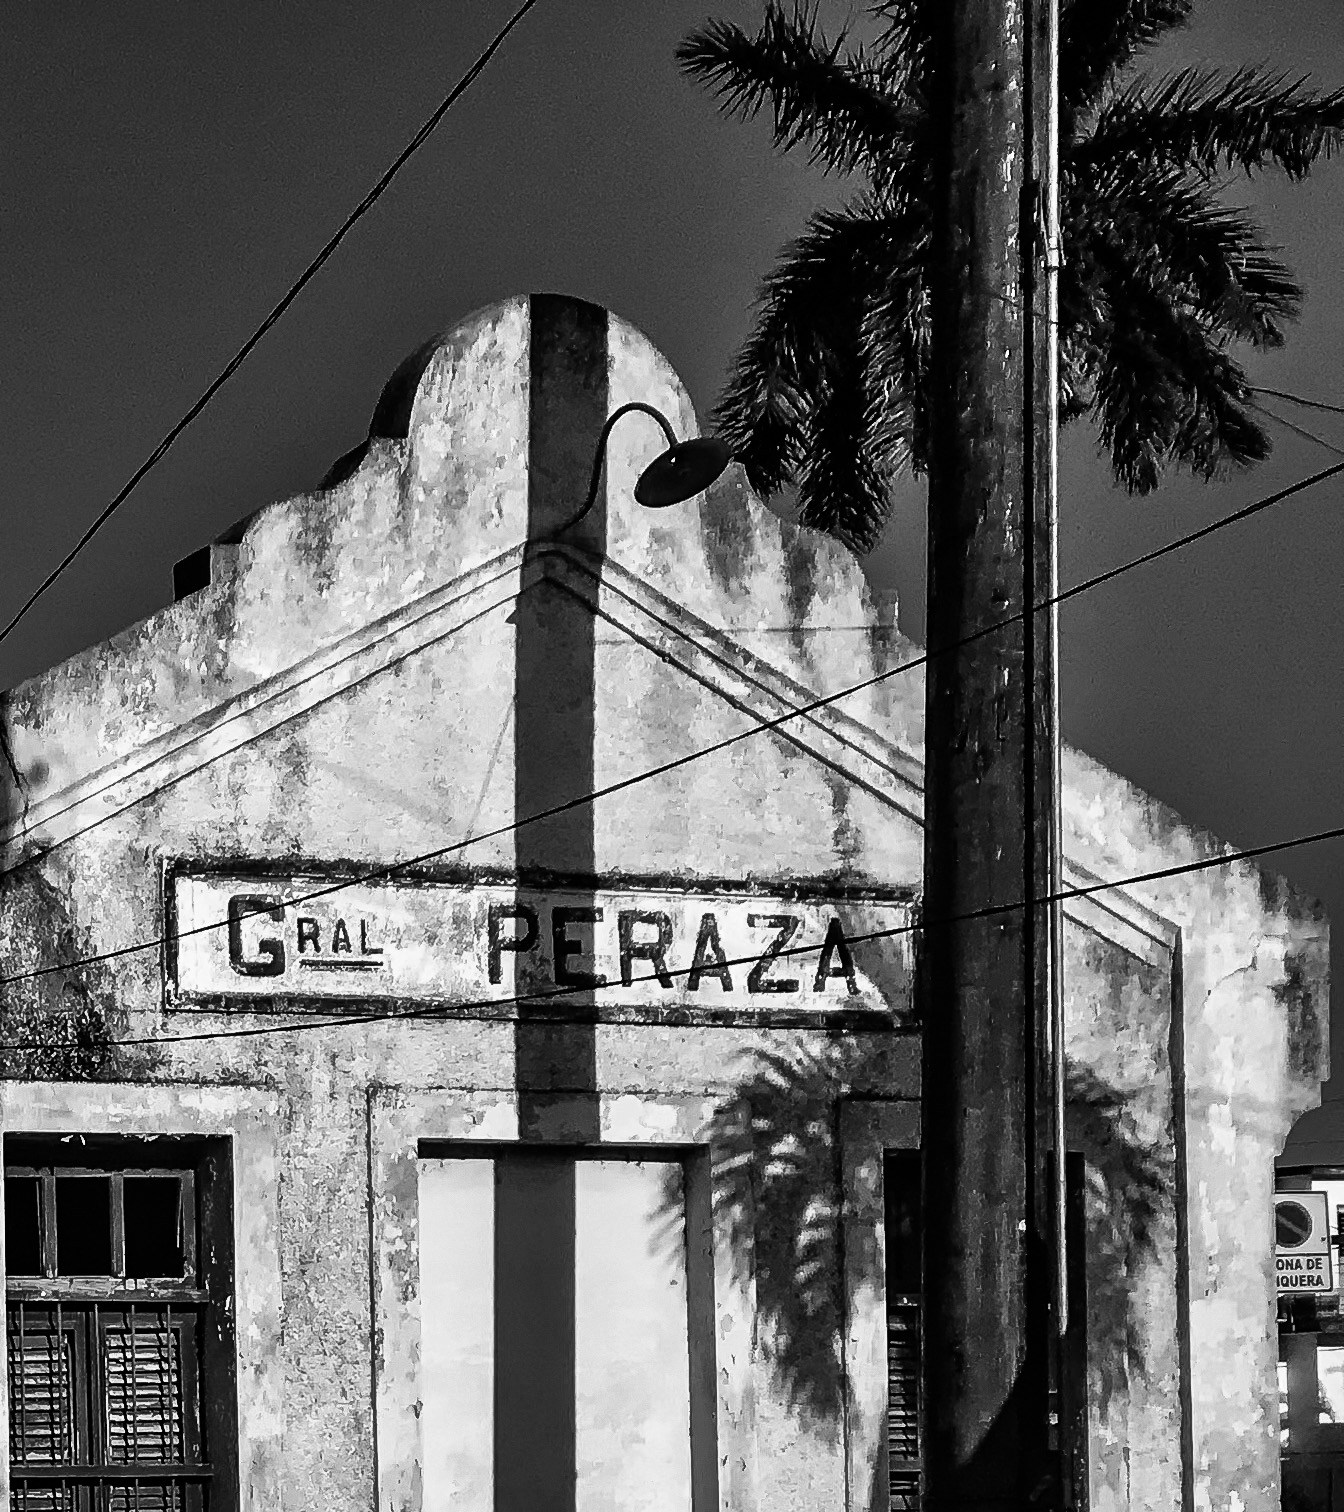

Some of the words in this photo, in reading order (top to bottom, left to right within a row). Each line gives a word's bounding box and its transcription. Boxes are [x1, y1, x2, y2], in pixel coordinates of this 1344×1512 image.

[487, 902, 862, 996] PERAZA
[1275, 1258, 1304, 1271] ONA
[1306, 1257, 1324, 1270] DE
[1276, 1274, 1325, 1288] IQUERA
